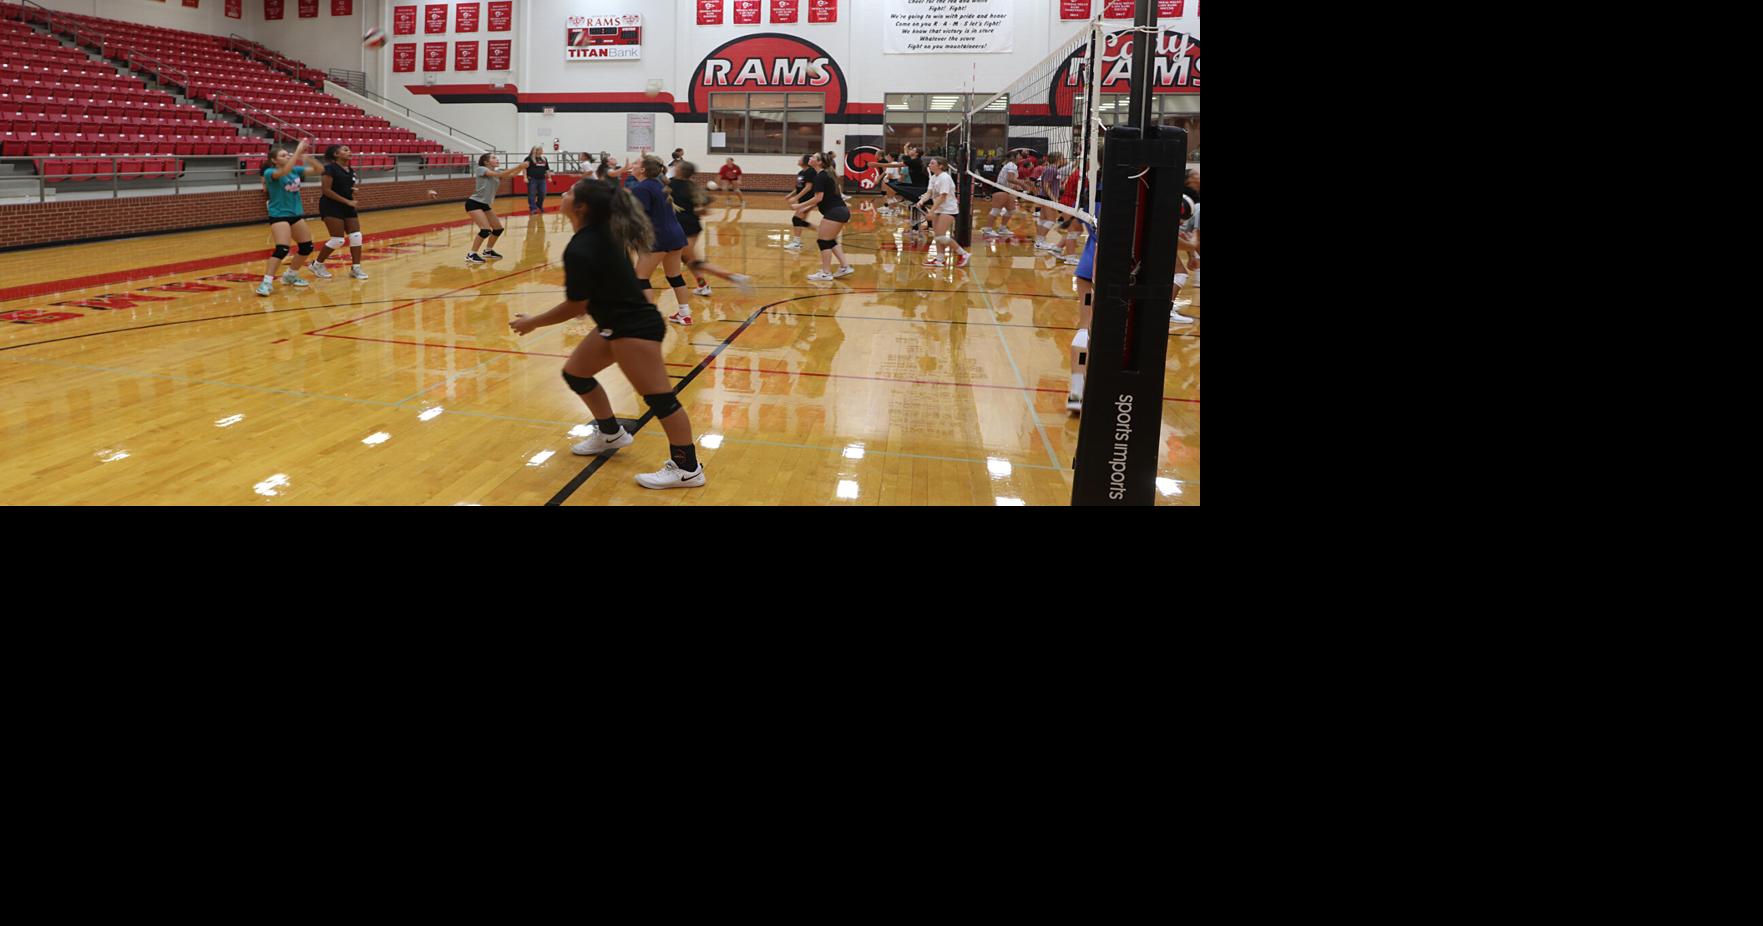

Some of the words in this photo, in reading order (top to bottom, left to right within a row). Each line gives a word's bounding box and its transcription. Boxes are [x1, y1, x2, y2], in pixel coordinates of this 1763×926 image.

[587, 17, 621, 26] RAMS
[984, 20, 1001, 28] fight!
[703, 57, 831, 87] RAMS
[1115, 394, 1134, 442] sports
[1108, 443, 1129, 500] imports
